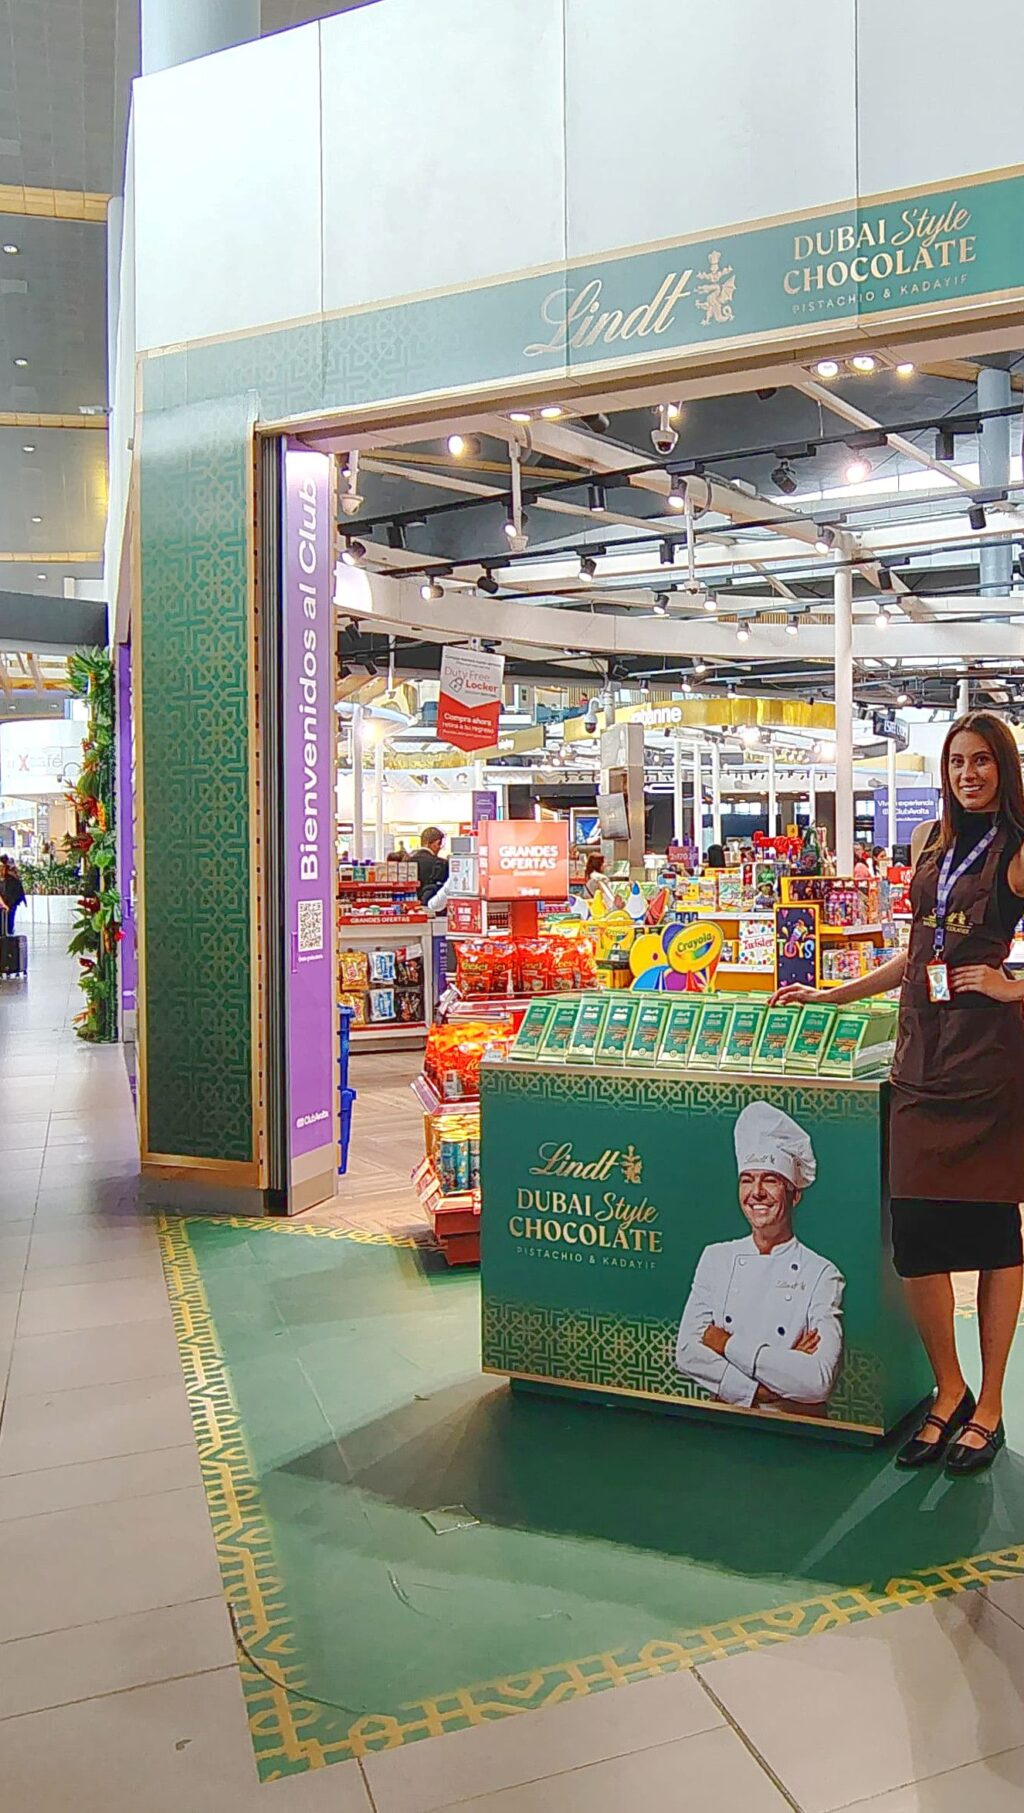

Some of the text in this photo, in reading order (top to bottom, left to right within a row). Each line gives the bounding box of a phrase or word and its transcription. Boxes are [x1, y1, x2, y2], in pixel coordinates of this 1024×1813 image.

[793, 200, 972, 261] DUBAI Style
[783, 235, 977, 295] CHOCOLATE
[792, 274, 969, 313] PISTACHIO & KADAYIF
[522, 268, 693, 357] Lindt
[299, 476, 319, 881] Bienvenidos al Club
[444, 667, 468, 680] Duty
[466, 680, 498, 692] Locker
[499, 845, 558, 858] GRANDES
[500, 858, 557, 870] OFERTAS
[677, 932, 714, 953] Crayola
[742, 938, 774, 949] Twister
[776, 939, 815, 959] TOYS
[528, 1142, 621, 1181] Lindt
[516, 1188, 661, 1229] DUBAI Style
[508, 1216, 664, 1254] CHOCOLATE
[516, 1245, 584, 1263] PISTACHIO
[603, 1257, 657, 1270] KADAYIF
